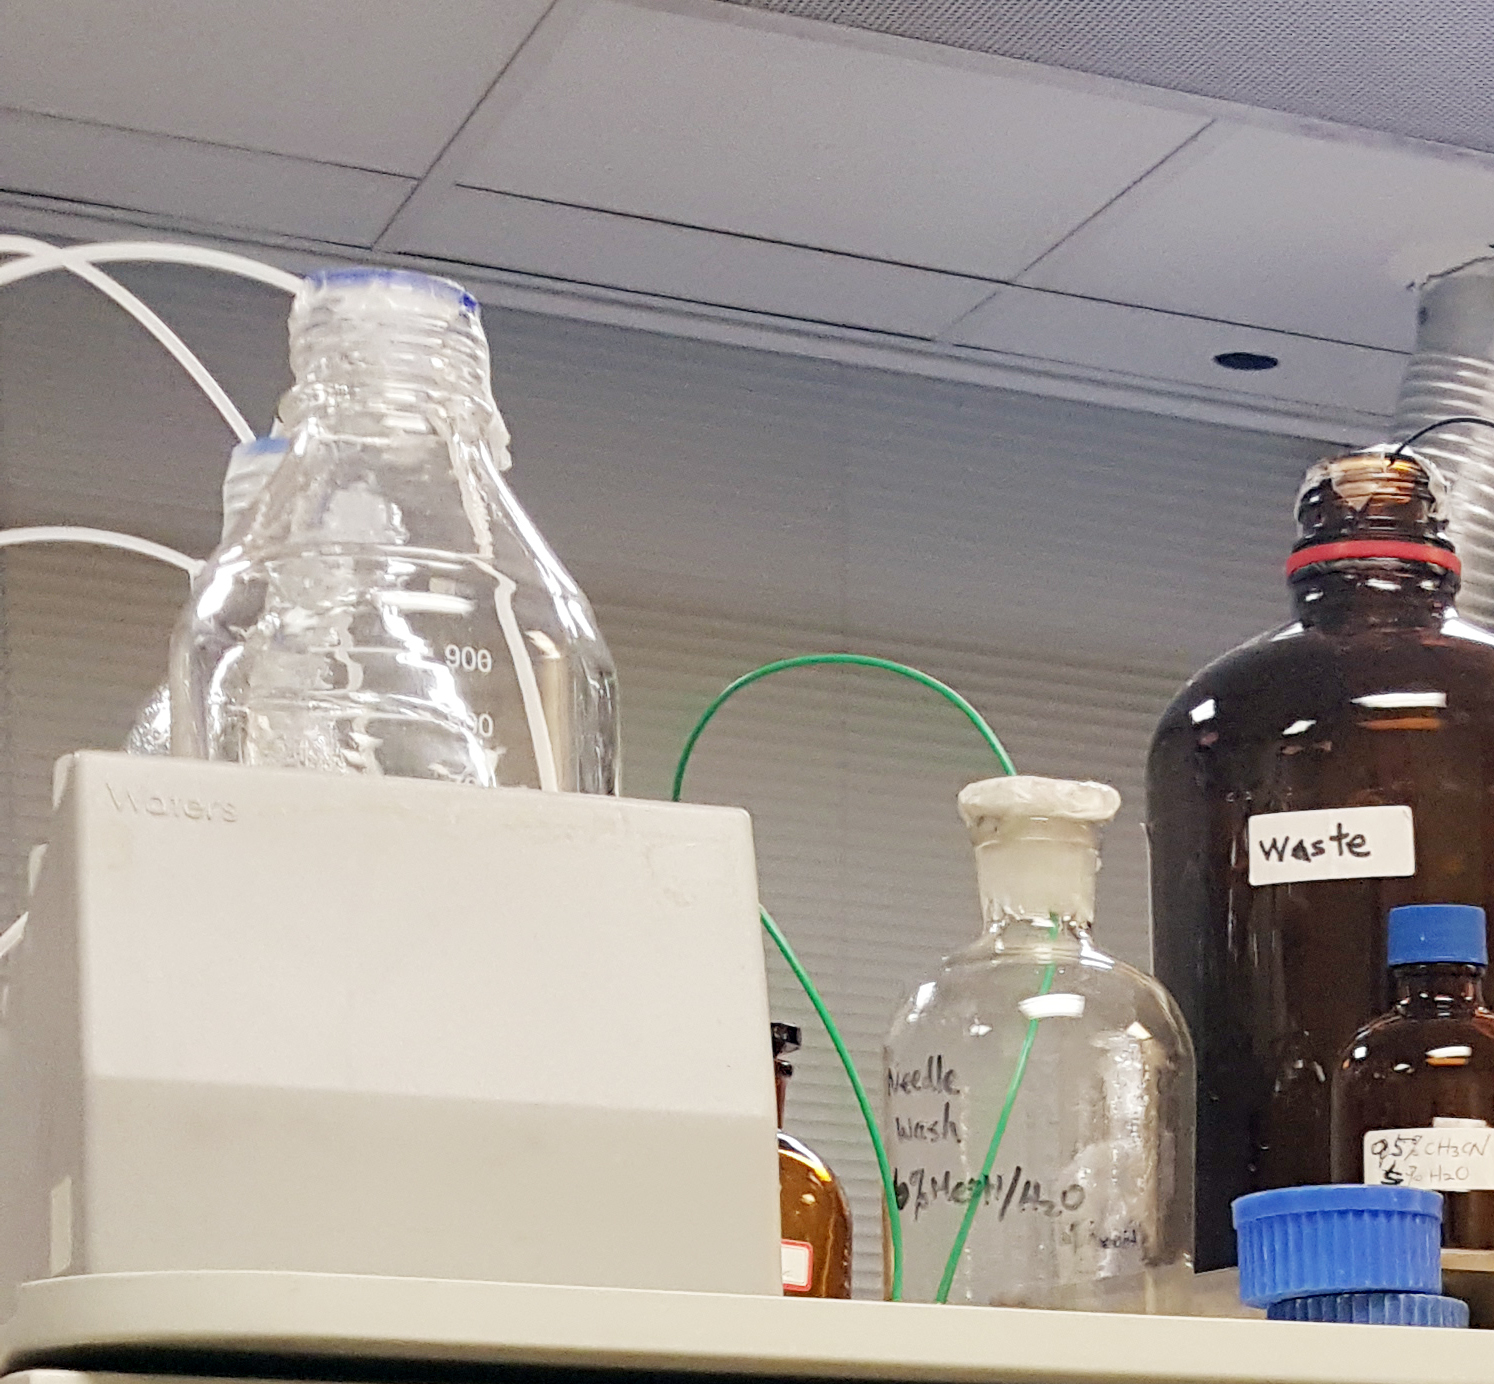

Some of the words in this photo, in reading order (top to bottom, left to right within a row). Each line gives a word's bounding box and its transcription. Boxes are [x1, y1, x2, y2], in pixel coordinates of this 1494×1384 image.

[445, 644, 493, 673] 900
[105, 782, 238, 823] Waters
[1429, 1164, 1470, 1182] H2O
